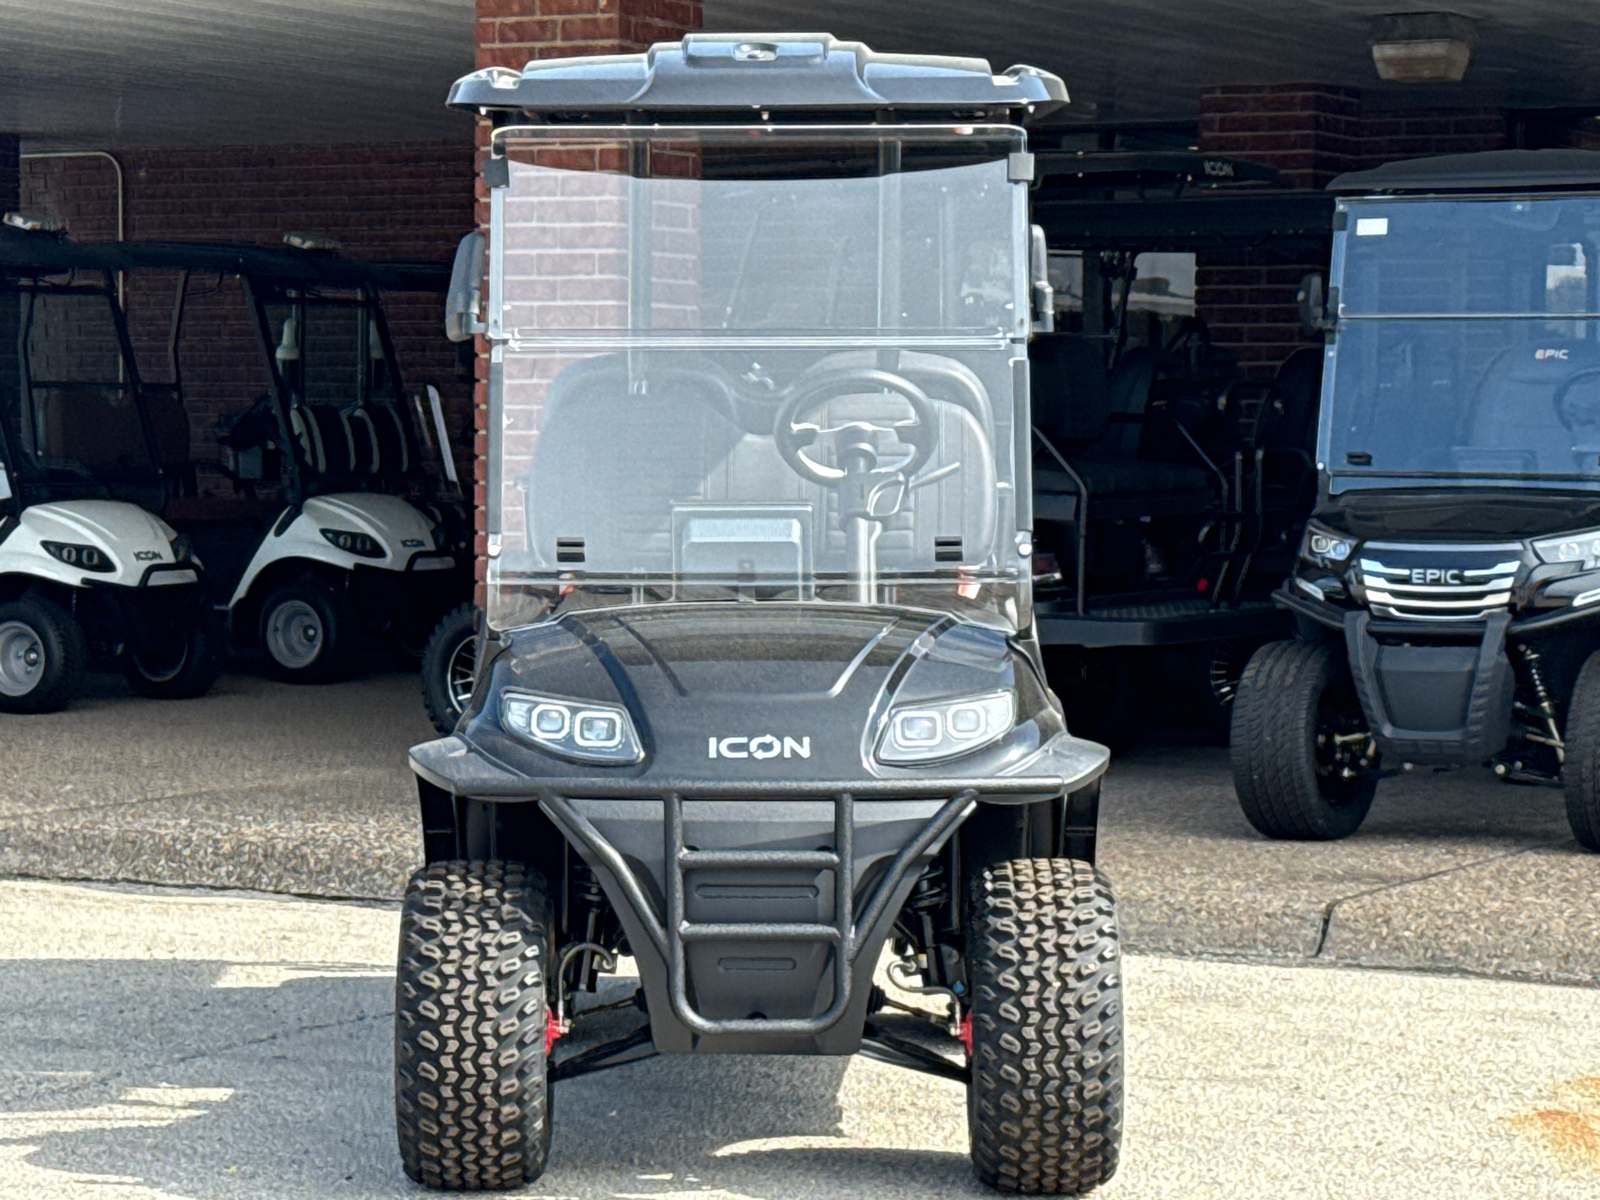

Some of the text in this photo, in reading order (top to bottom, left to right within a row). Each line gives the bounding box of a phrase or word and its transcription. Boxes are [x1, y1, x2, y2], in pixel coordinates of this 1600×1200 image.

[1534, 349, 1569, 360] EPIC
[133, 550, 163, 562] ICON
[1411, 568, 1461, 584] EPIC
[708, 734, 811, 760] ICON
